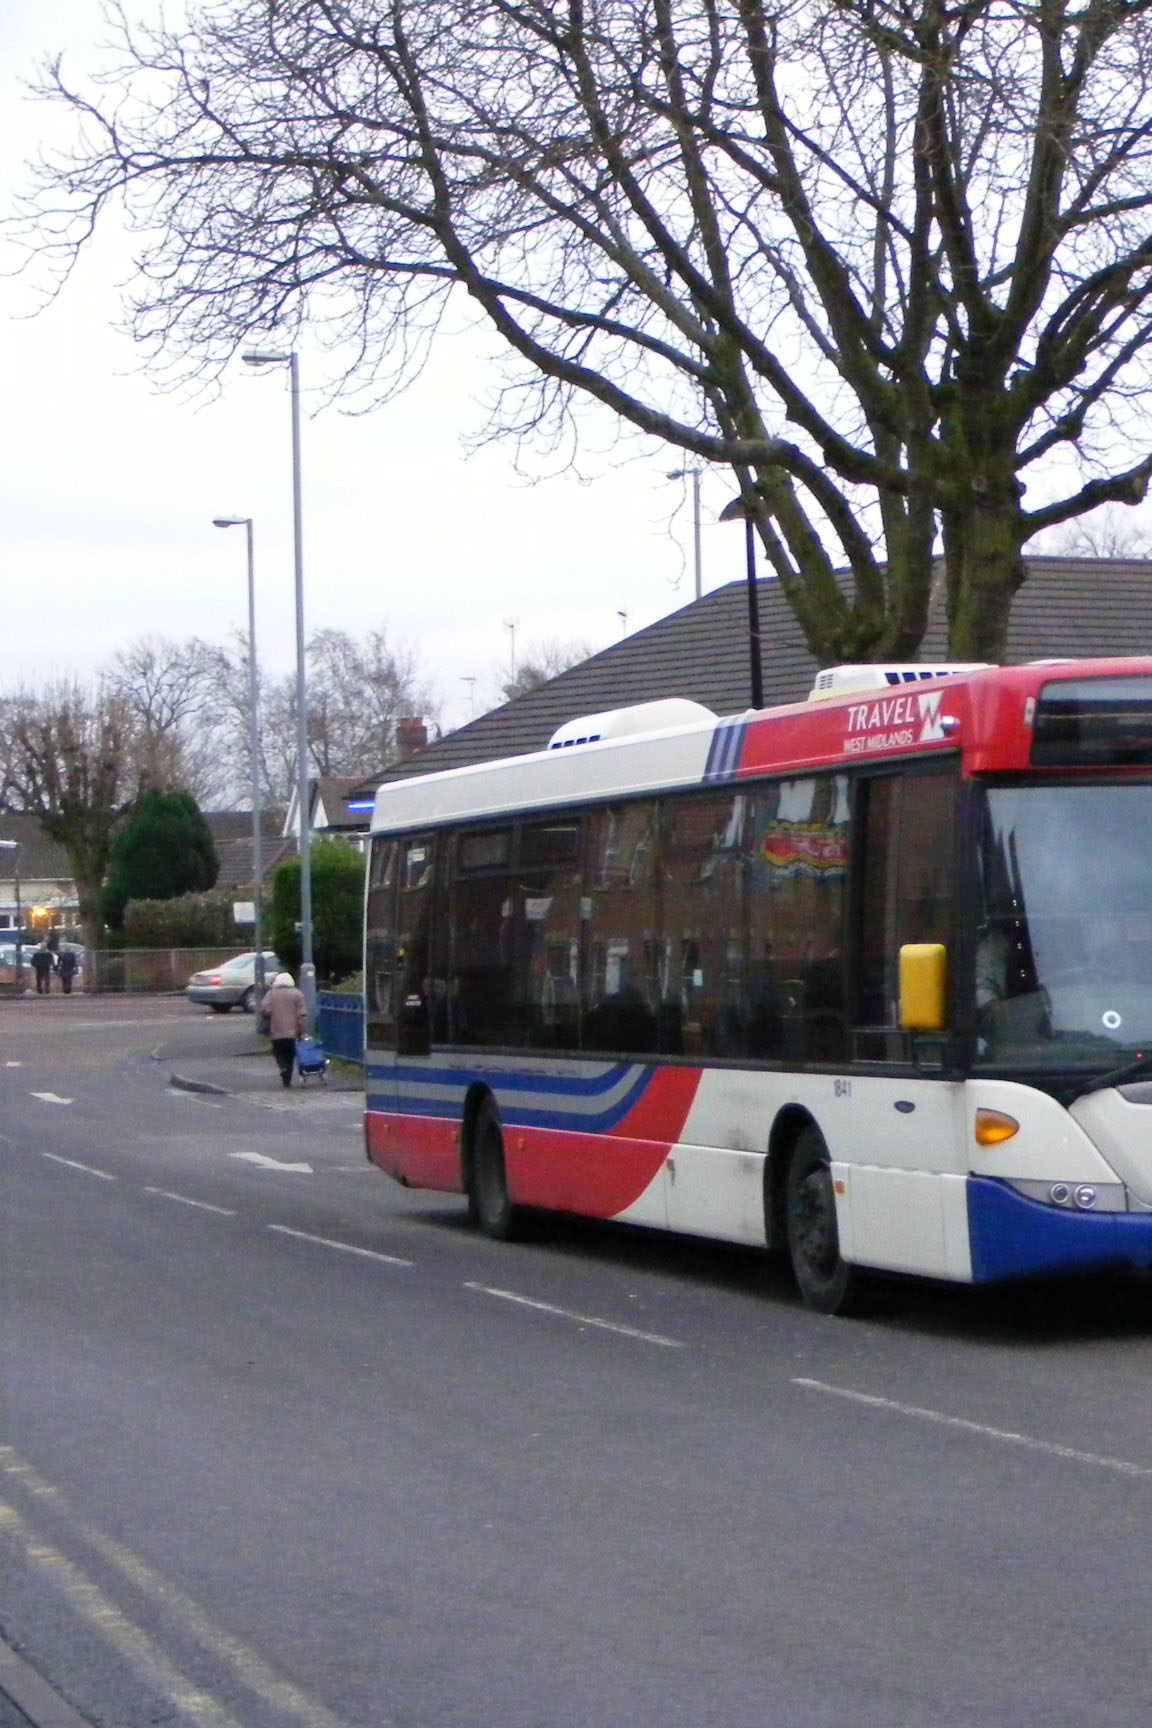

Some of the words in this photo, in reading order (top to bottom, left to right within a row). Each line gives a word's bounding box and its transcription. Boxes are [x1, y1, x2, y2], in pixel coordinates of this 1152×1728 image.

[847, 696, 915, 732] TRAVEL
[844, 737, 866, 753] WEST
[867, 729, 914, 750] MIDLANDS
